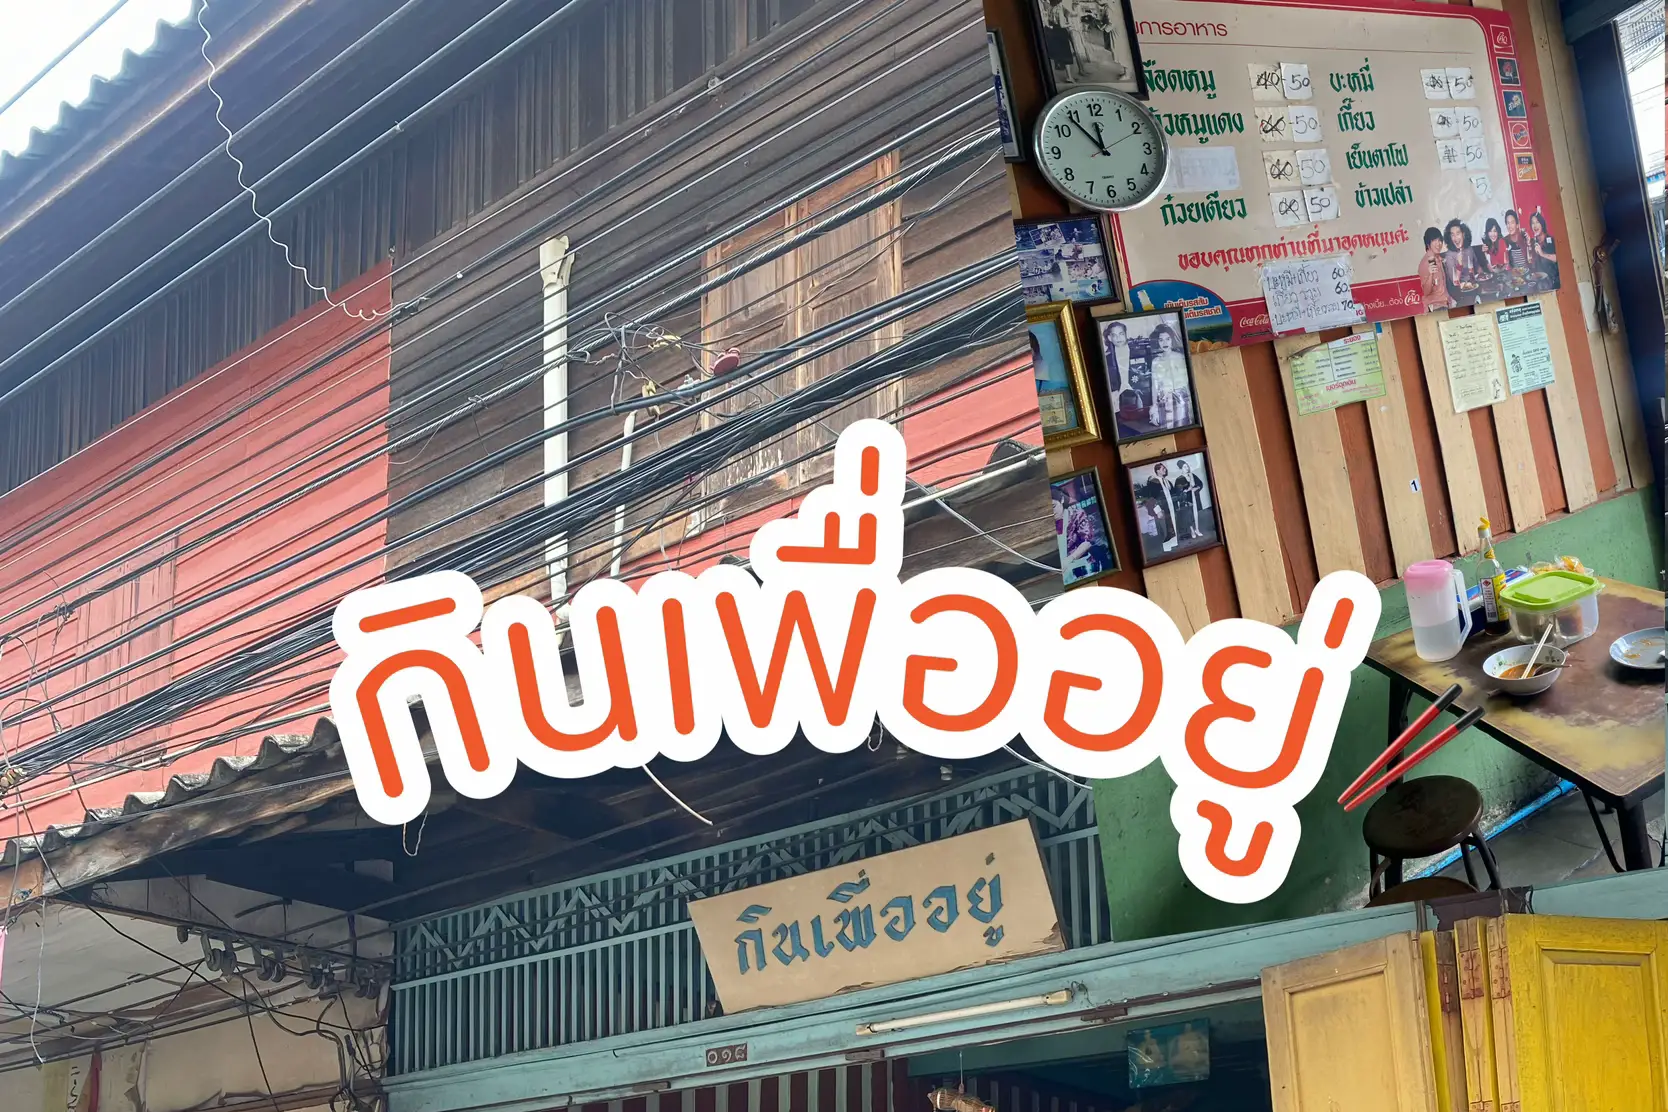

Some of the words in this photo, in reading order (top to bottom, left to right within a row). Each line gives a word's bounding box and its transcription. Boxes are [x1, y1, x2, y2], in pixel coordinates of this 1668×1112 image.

[1329, 57, 1375, 93] บะหมี่
[1067, 110, 1080, 123] 11
[1086, 103, 1103, 117] 12
[1115, 108, 1122, 121] 1
[1337, 97, 1376, 133] เกี๊ยว
[1054, 124, 1071, 138] 10
[1132, 122, 1141, 134] 2
[1051, 146, 1061, 159] 9
[1143, 143, 1152, 155] 3
[1346, 141, 1409, 171] เย็นตาโฟ
[1064, 167, 1074, 181] 8
[1140, 163, 1149, 175] 4
[1086, 181, 1095, 194] 7
[1127, 178, 1136, 191] 5
[1107, 185, 1117, 198] 6
[1355, 179, 1414, 209] ข้าวเปล่า
[1411, 480, 1418, 491] 1
[734, 852, 1004, 975] กินเพื่ออยู่
